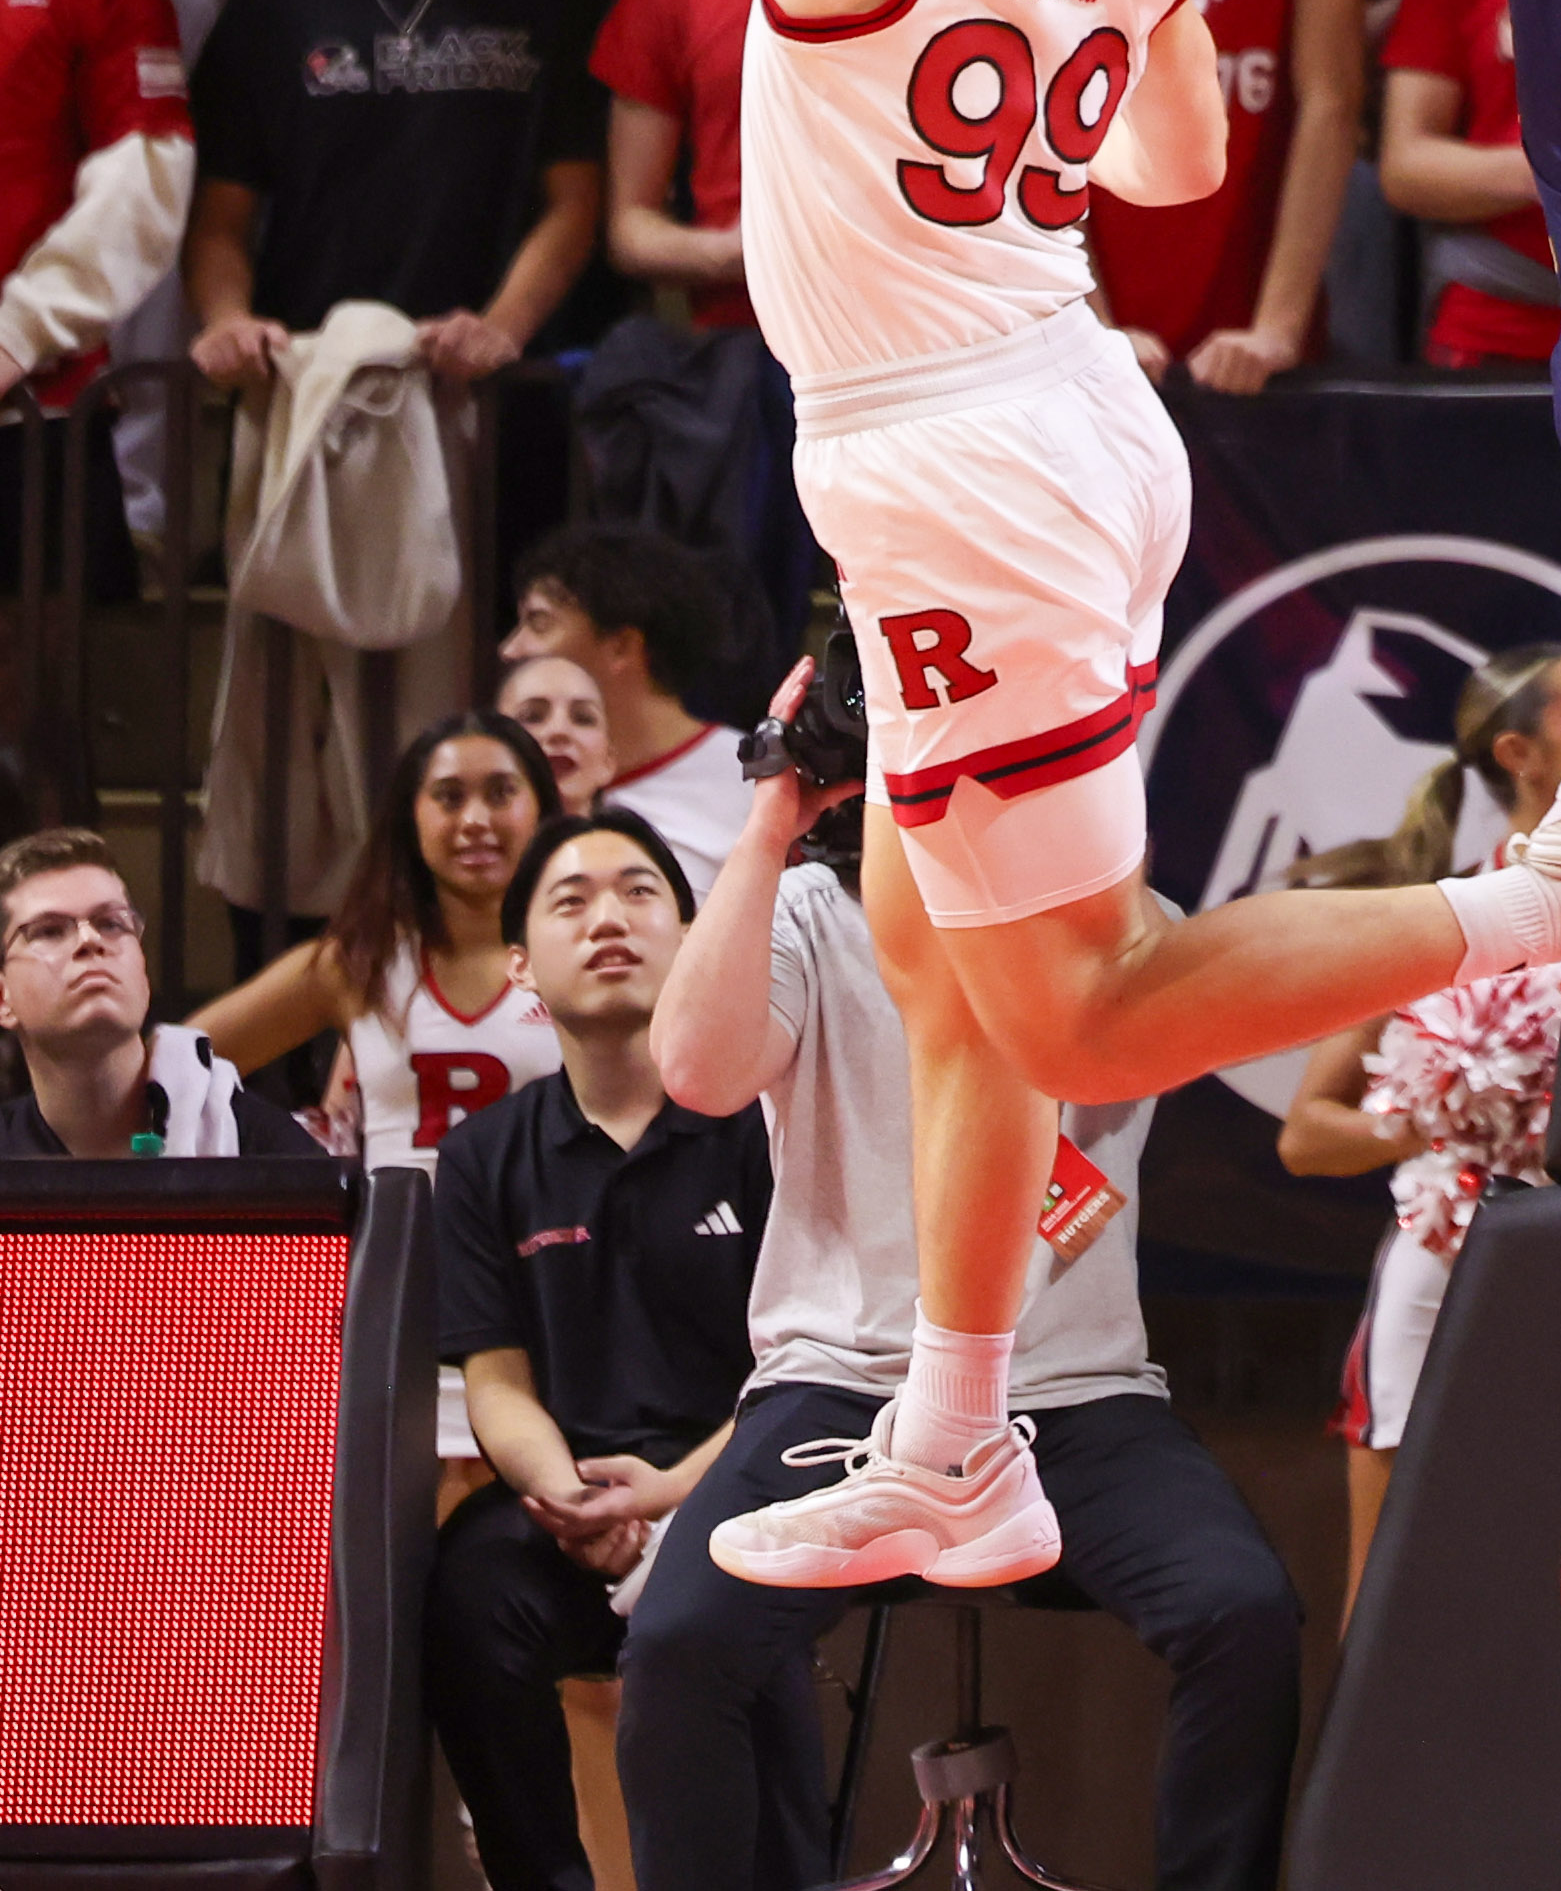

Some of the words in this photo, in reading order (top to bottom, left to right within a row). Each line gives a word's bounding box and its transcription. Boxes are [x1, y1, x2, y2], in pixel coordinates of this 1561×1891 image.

[897, 18, 1130, 230] 99
[878, 609, 998, 710] R
[1057, 1189, 1111, 1245] RUTGERS
